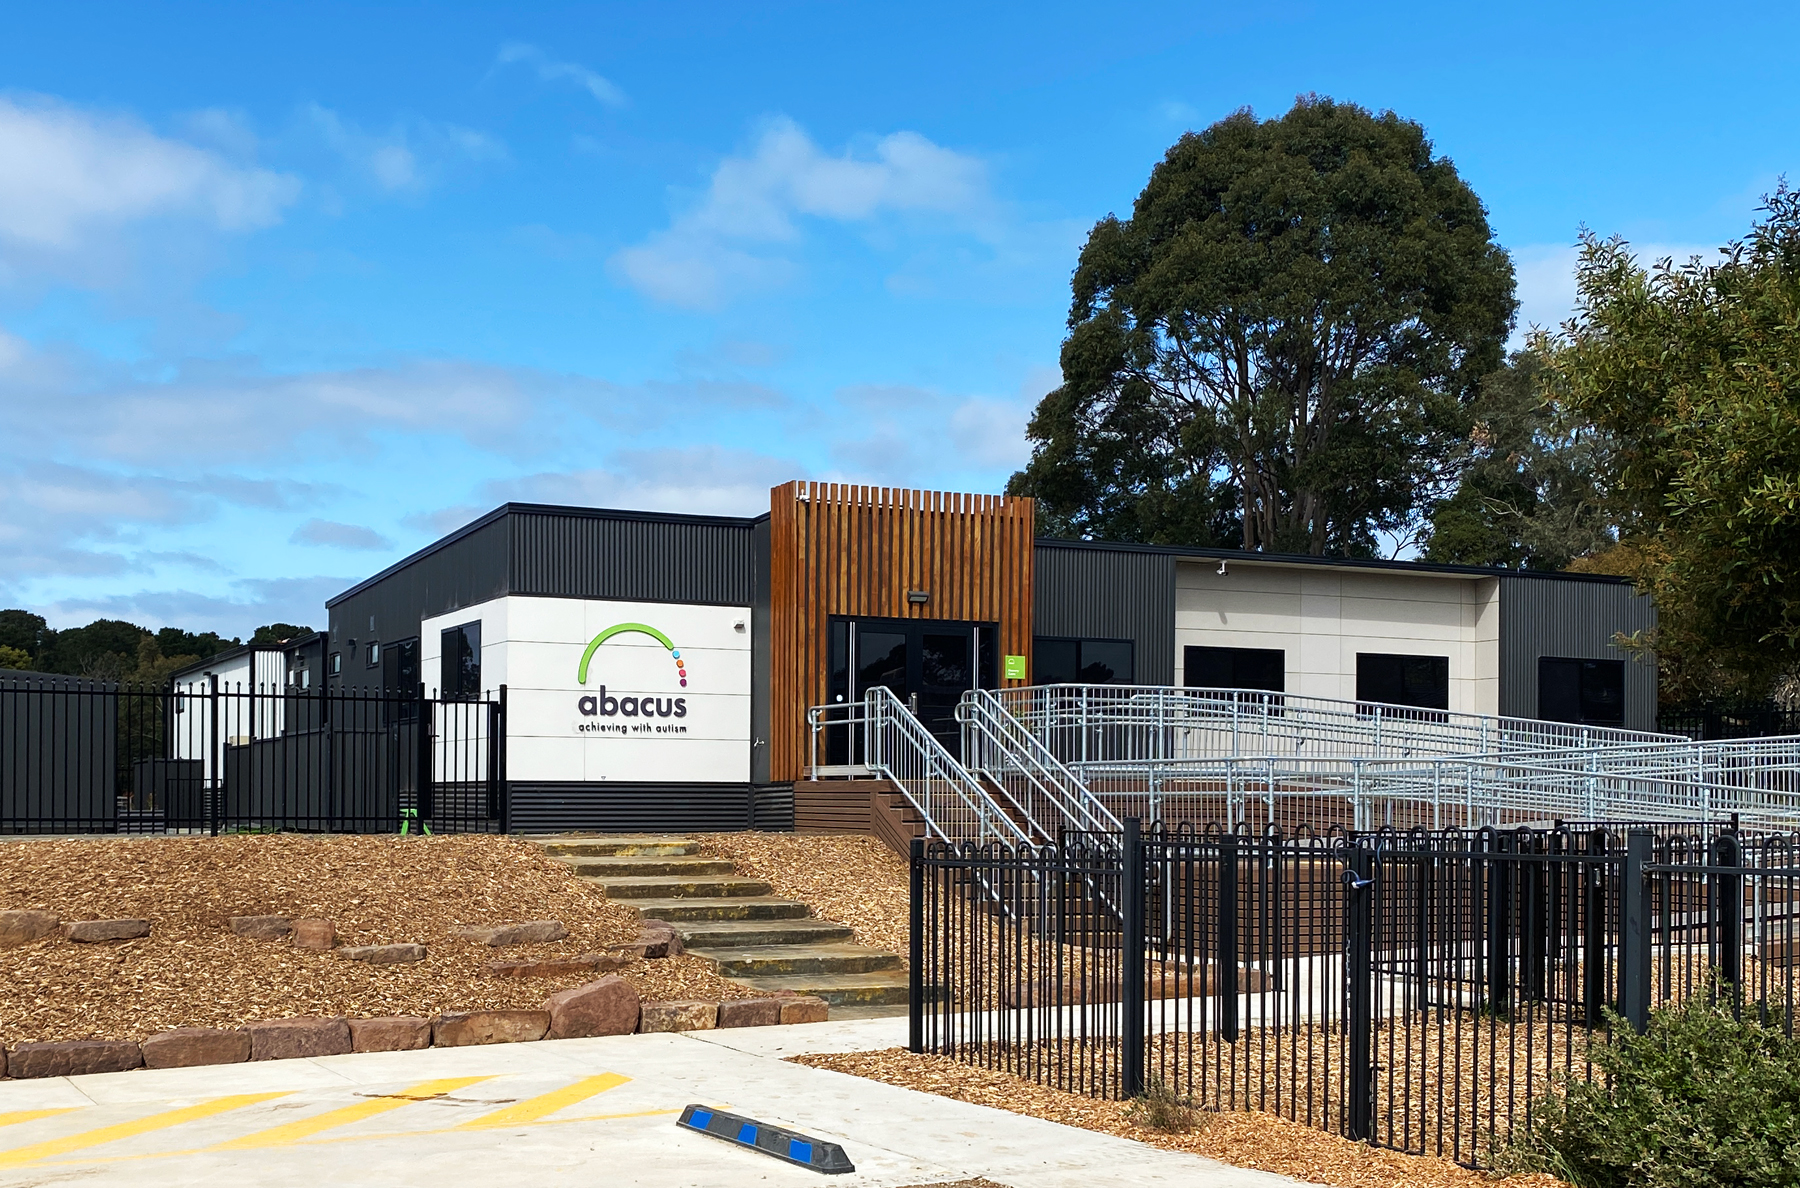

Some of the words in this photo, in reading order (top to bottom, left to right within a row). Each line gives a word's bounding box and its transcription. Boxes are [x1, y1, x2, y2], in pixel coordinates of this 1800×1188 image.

[578, 685, 687, 718] abacus
[578, 721, 627, 735] achieving
[631, 722, 652, 733] with
[655, 724, 687, 733] autism
